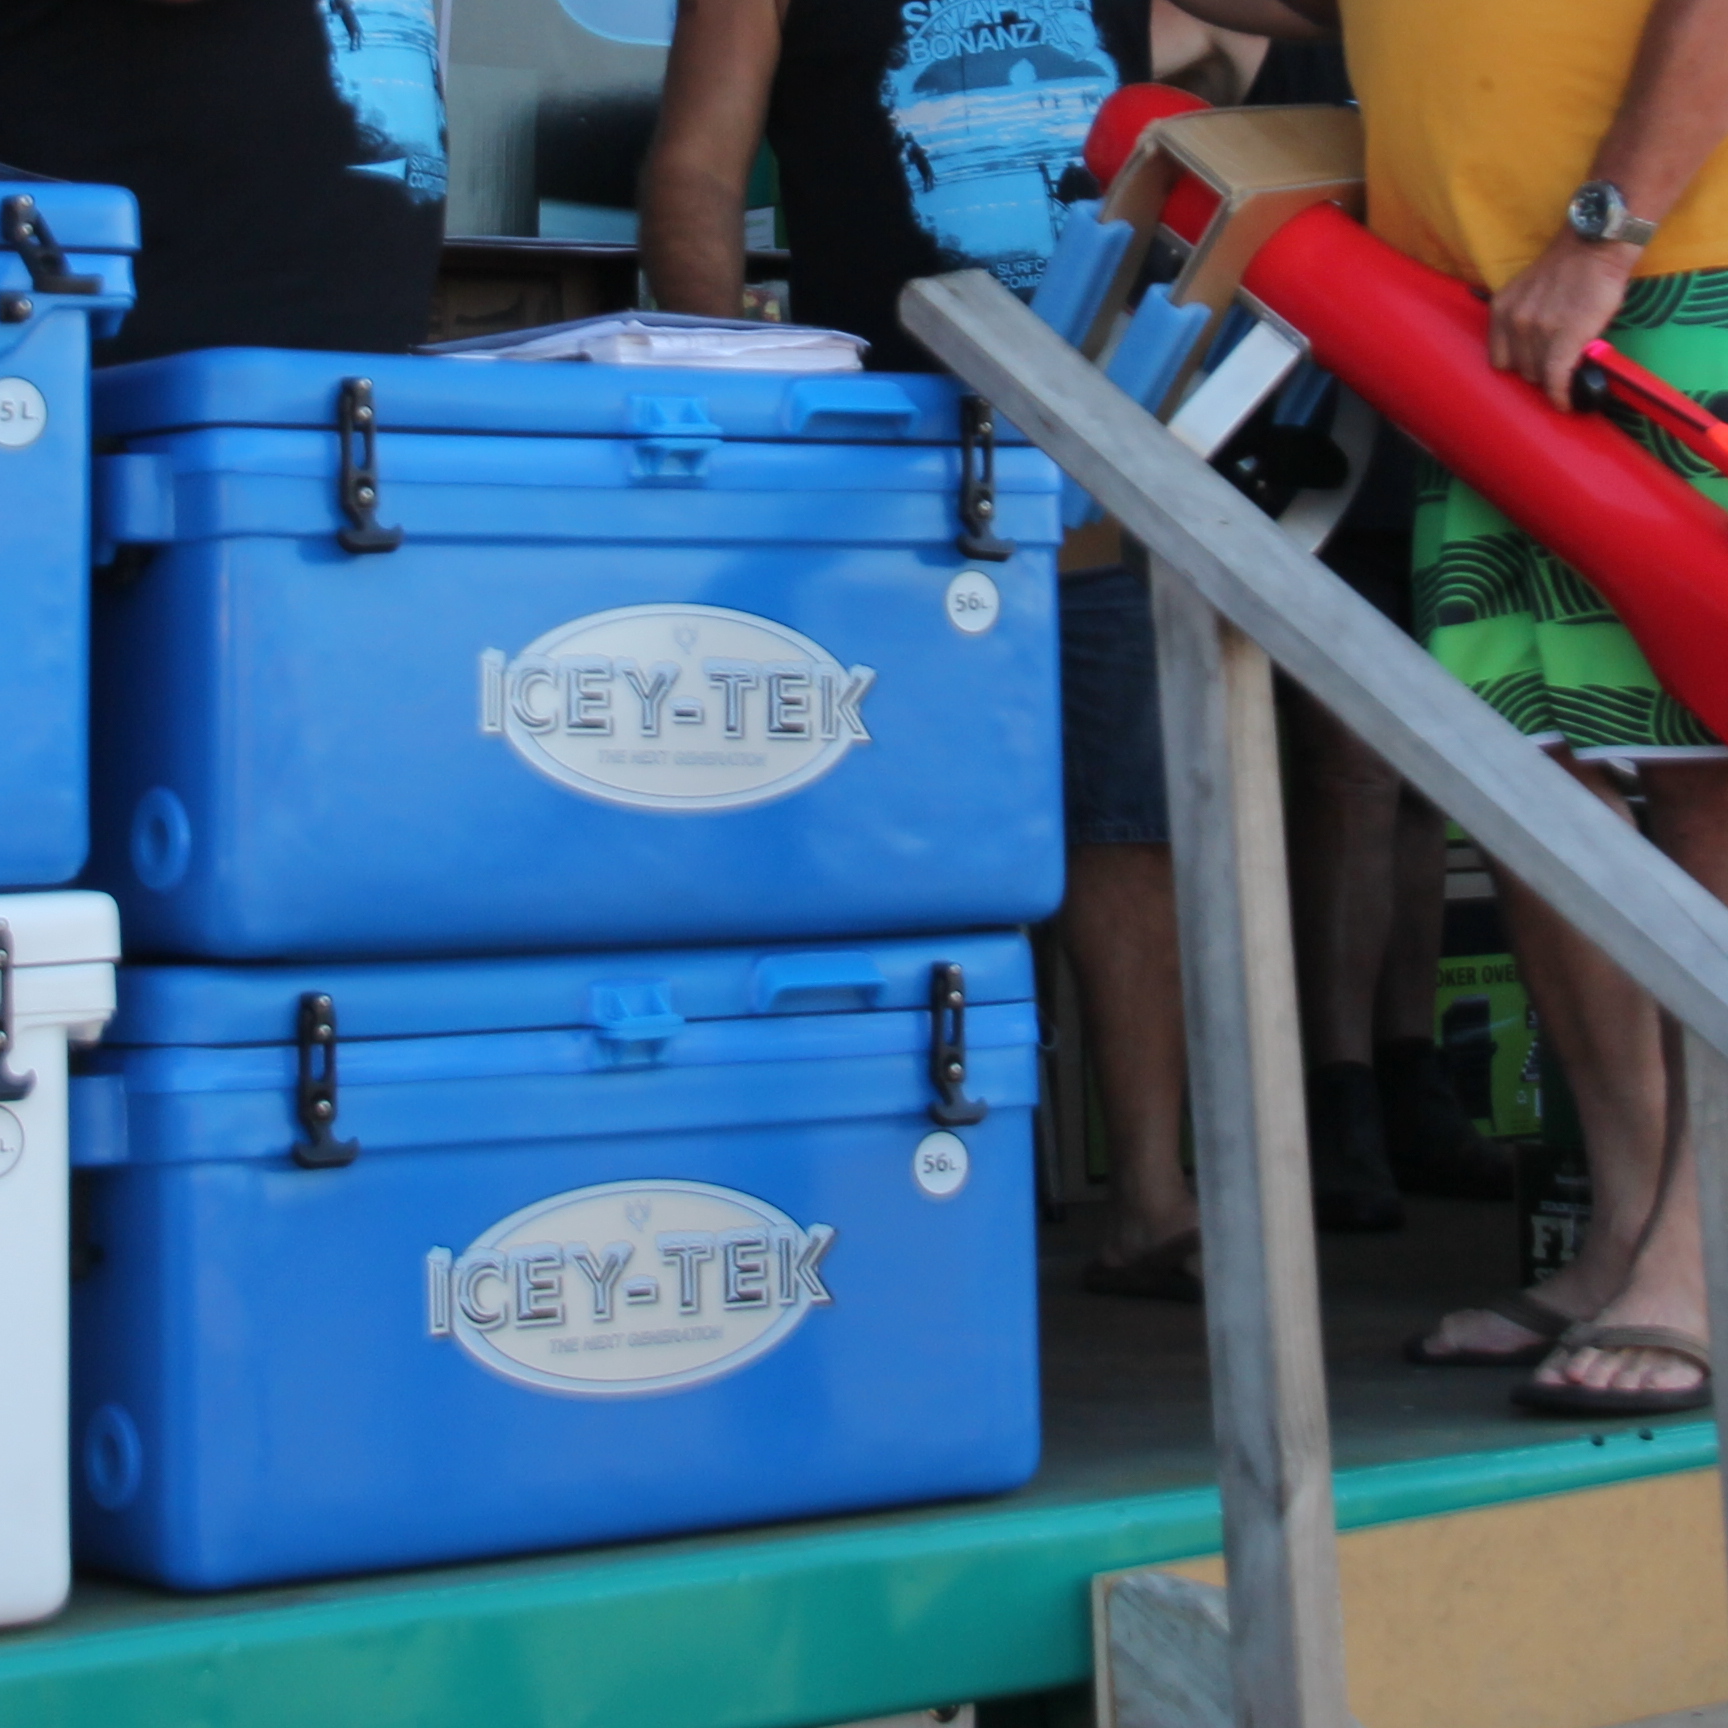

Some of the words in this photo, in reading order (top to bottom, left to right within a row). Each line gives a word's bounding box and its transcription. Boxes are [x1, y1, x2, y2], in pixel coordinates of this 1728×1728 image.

[908, 19, 1068, 64] BONANZA
[479, 647, 877, 743] ICEY-TEK
[426, 1222, 838, 1338] ICEY-TEK
